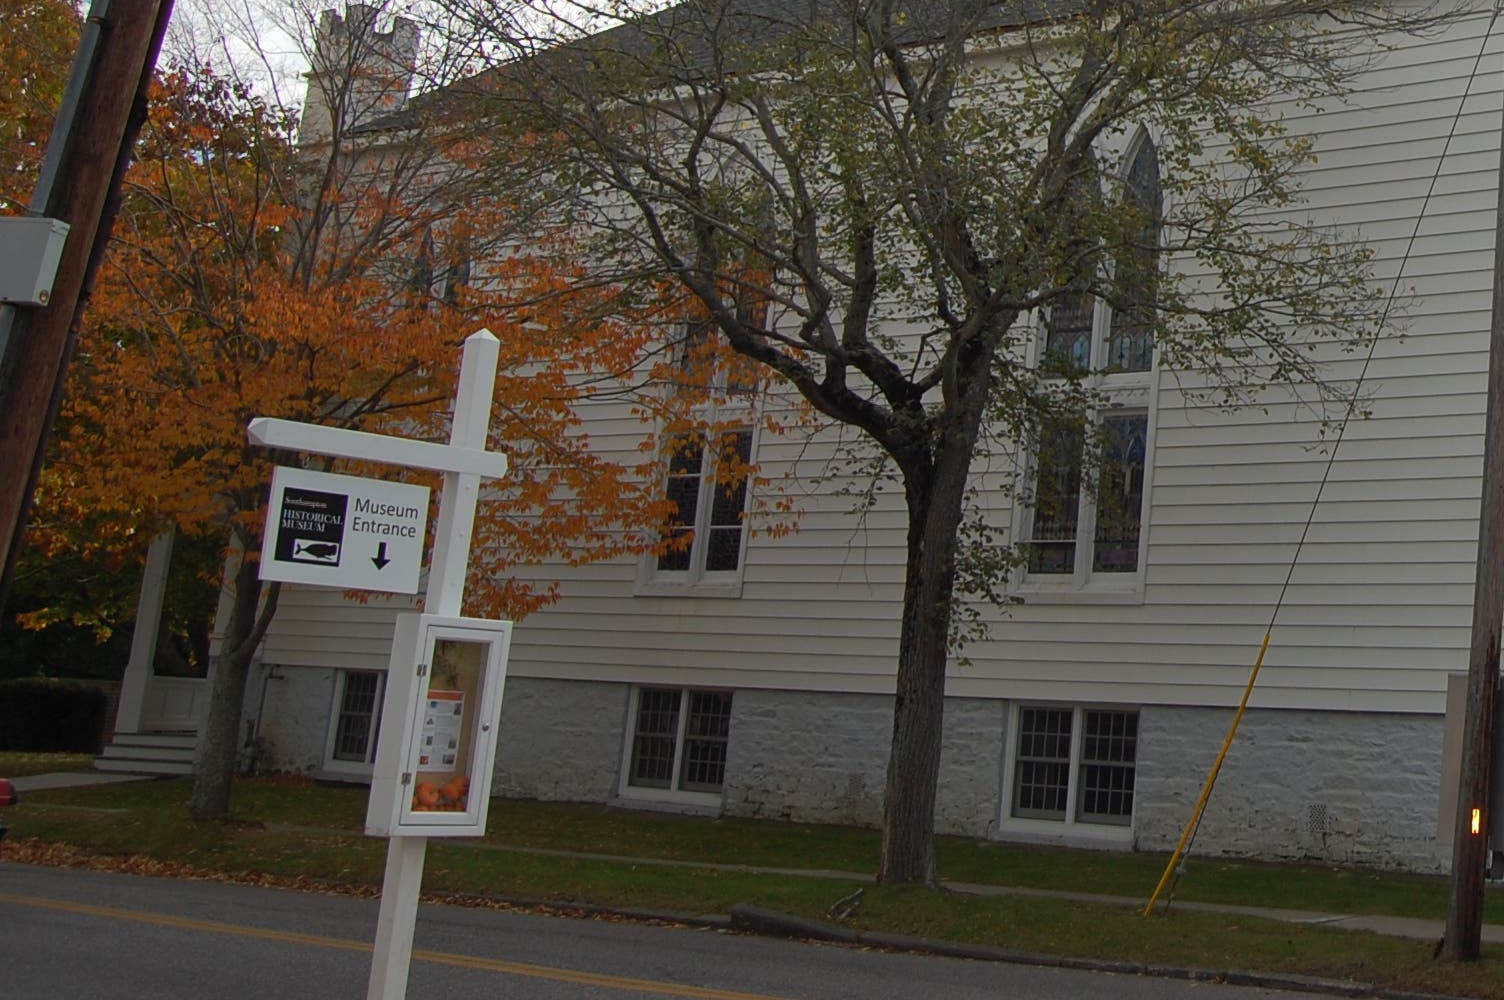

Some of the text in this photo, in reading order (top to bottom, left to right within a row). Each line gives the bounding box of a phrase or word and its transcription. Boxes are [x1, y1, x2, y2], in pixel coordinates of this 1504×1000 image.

[283, 509, 344, 526] HISTORICAL
[354, 498, 418, 520] Museum
[282, 519, 326, 532] MUSEUM
[352, 517, 416, 538] Entrance
